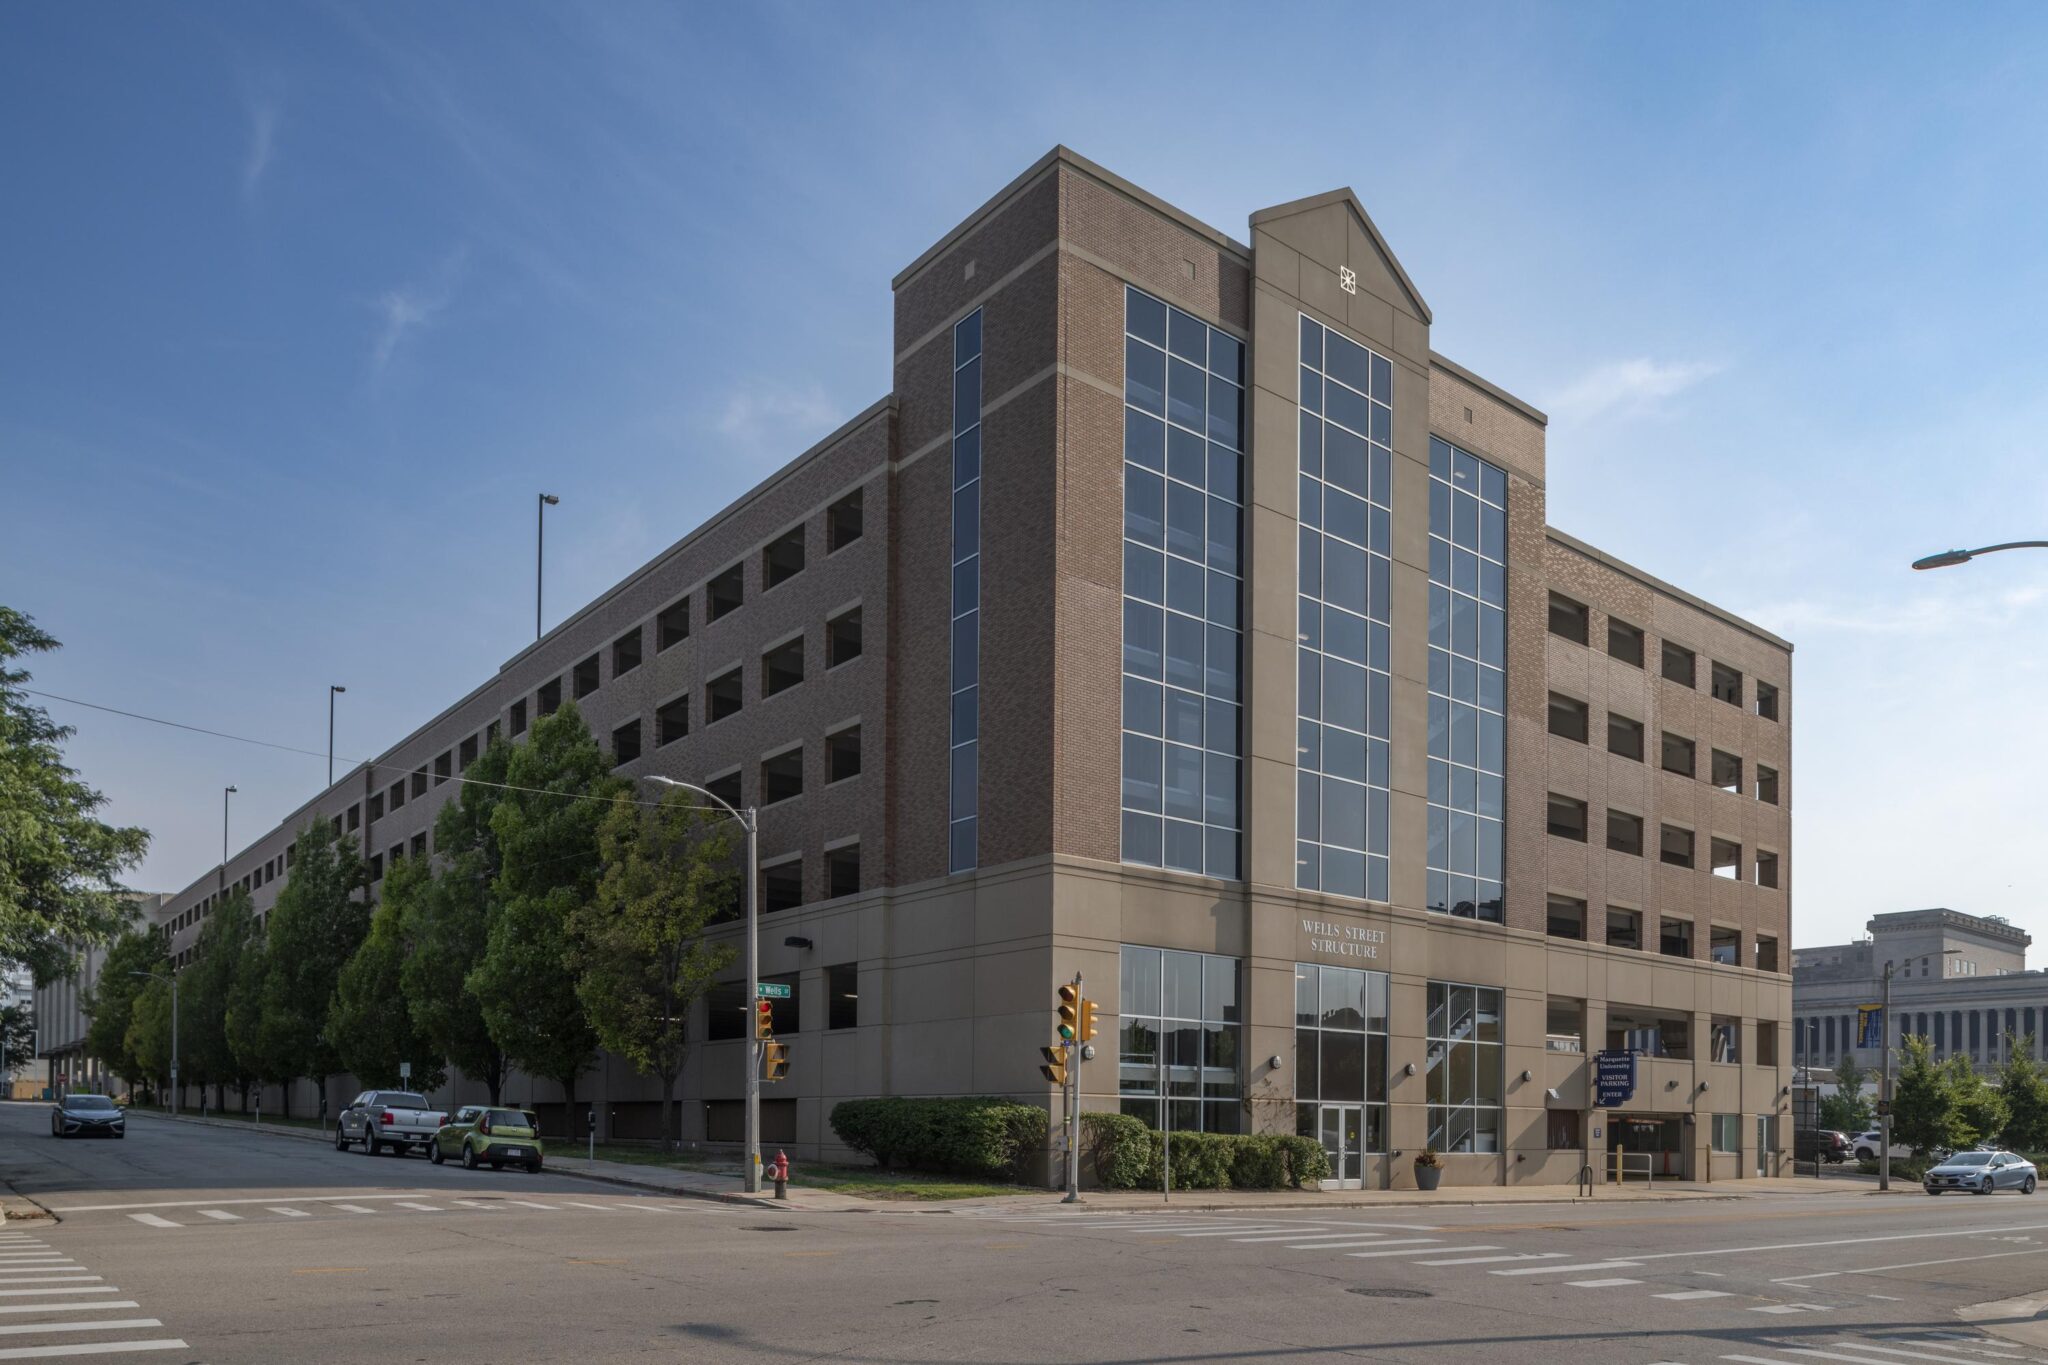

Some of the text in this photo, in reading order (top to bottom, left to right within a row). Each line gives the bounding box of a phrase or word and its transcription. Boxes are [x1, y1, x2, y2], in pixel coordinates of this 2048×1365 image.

[1302, 919, 1386, 944] WELLS STREET
[1311, 938, 1377, 959] STRUCTURE
[765, 986, 782, 995] Wells
